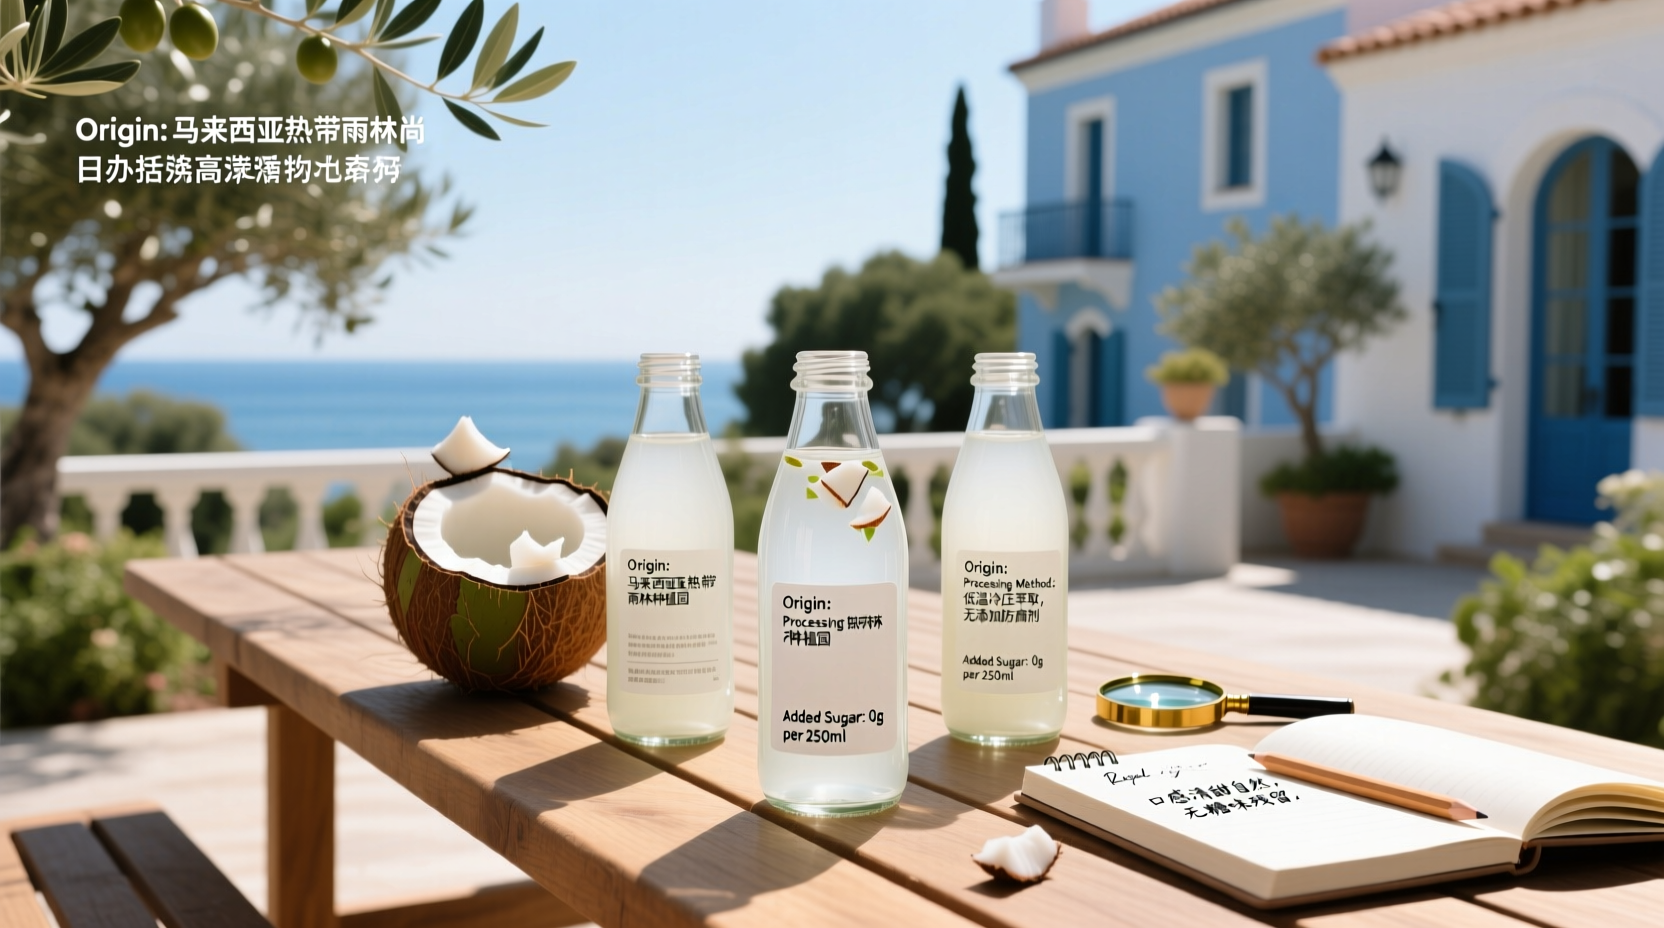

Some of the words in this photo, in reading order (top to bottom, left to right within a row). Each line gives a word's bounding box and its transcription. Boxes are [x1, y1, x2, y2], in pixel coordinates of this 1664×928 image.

[627, 558, 670, 575] Origin:
[964, 560, 1008, 577] Origin:
[1015, 577, 1056, 589] Method:
[782, 596, 831, 614] Origin:
[996, 656, 1029, 670] Sugar:
[1031, 655, 1044, 669] 0g
[981, 669, 1014, 681] 250ml
[782, 709, 821, 724] Added
[824, 711, 866, 727] Sugar:
[868, 709, 884, 726] 0g
[783, 729, 804, 743] per
[805, 728, 846, 743] 250ml
